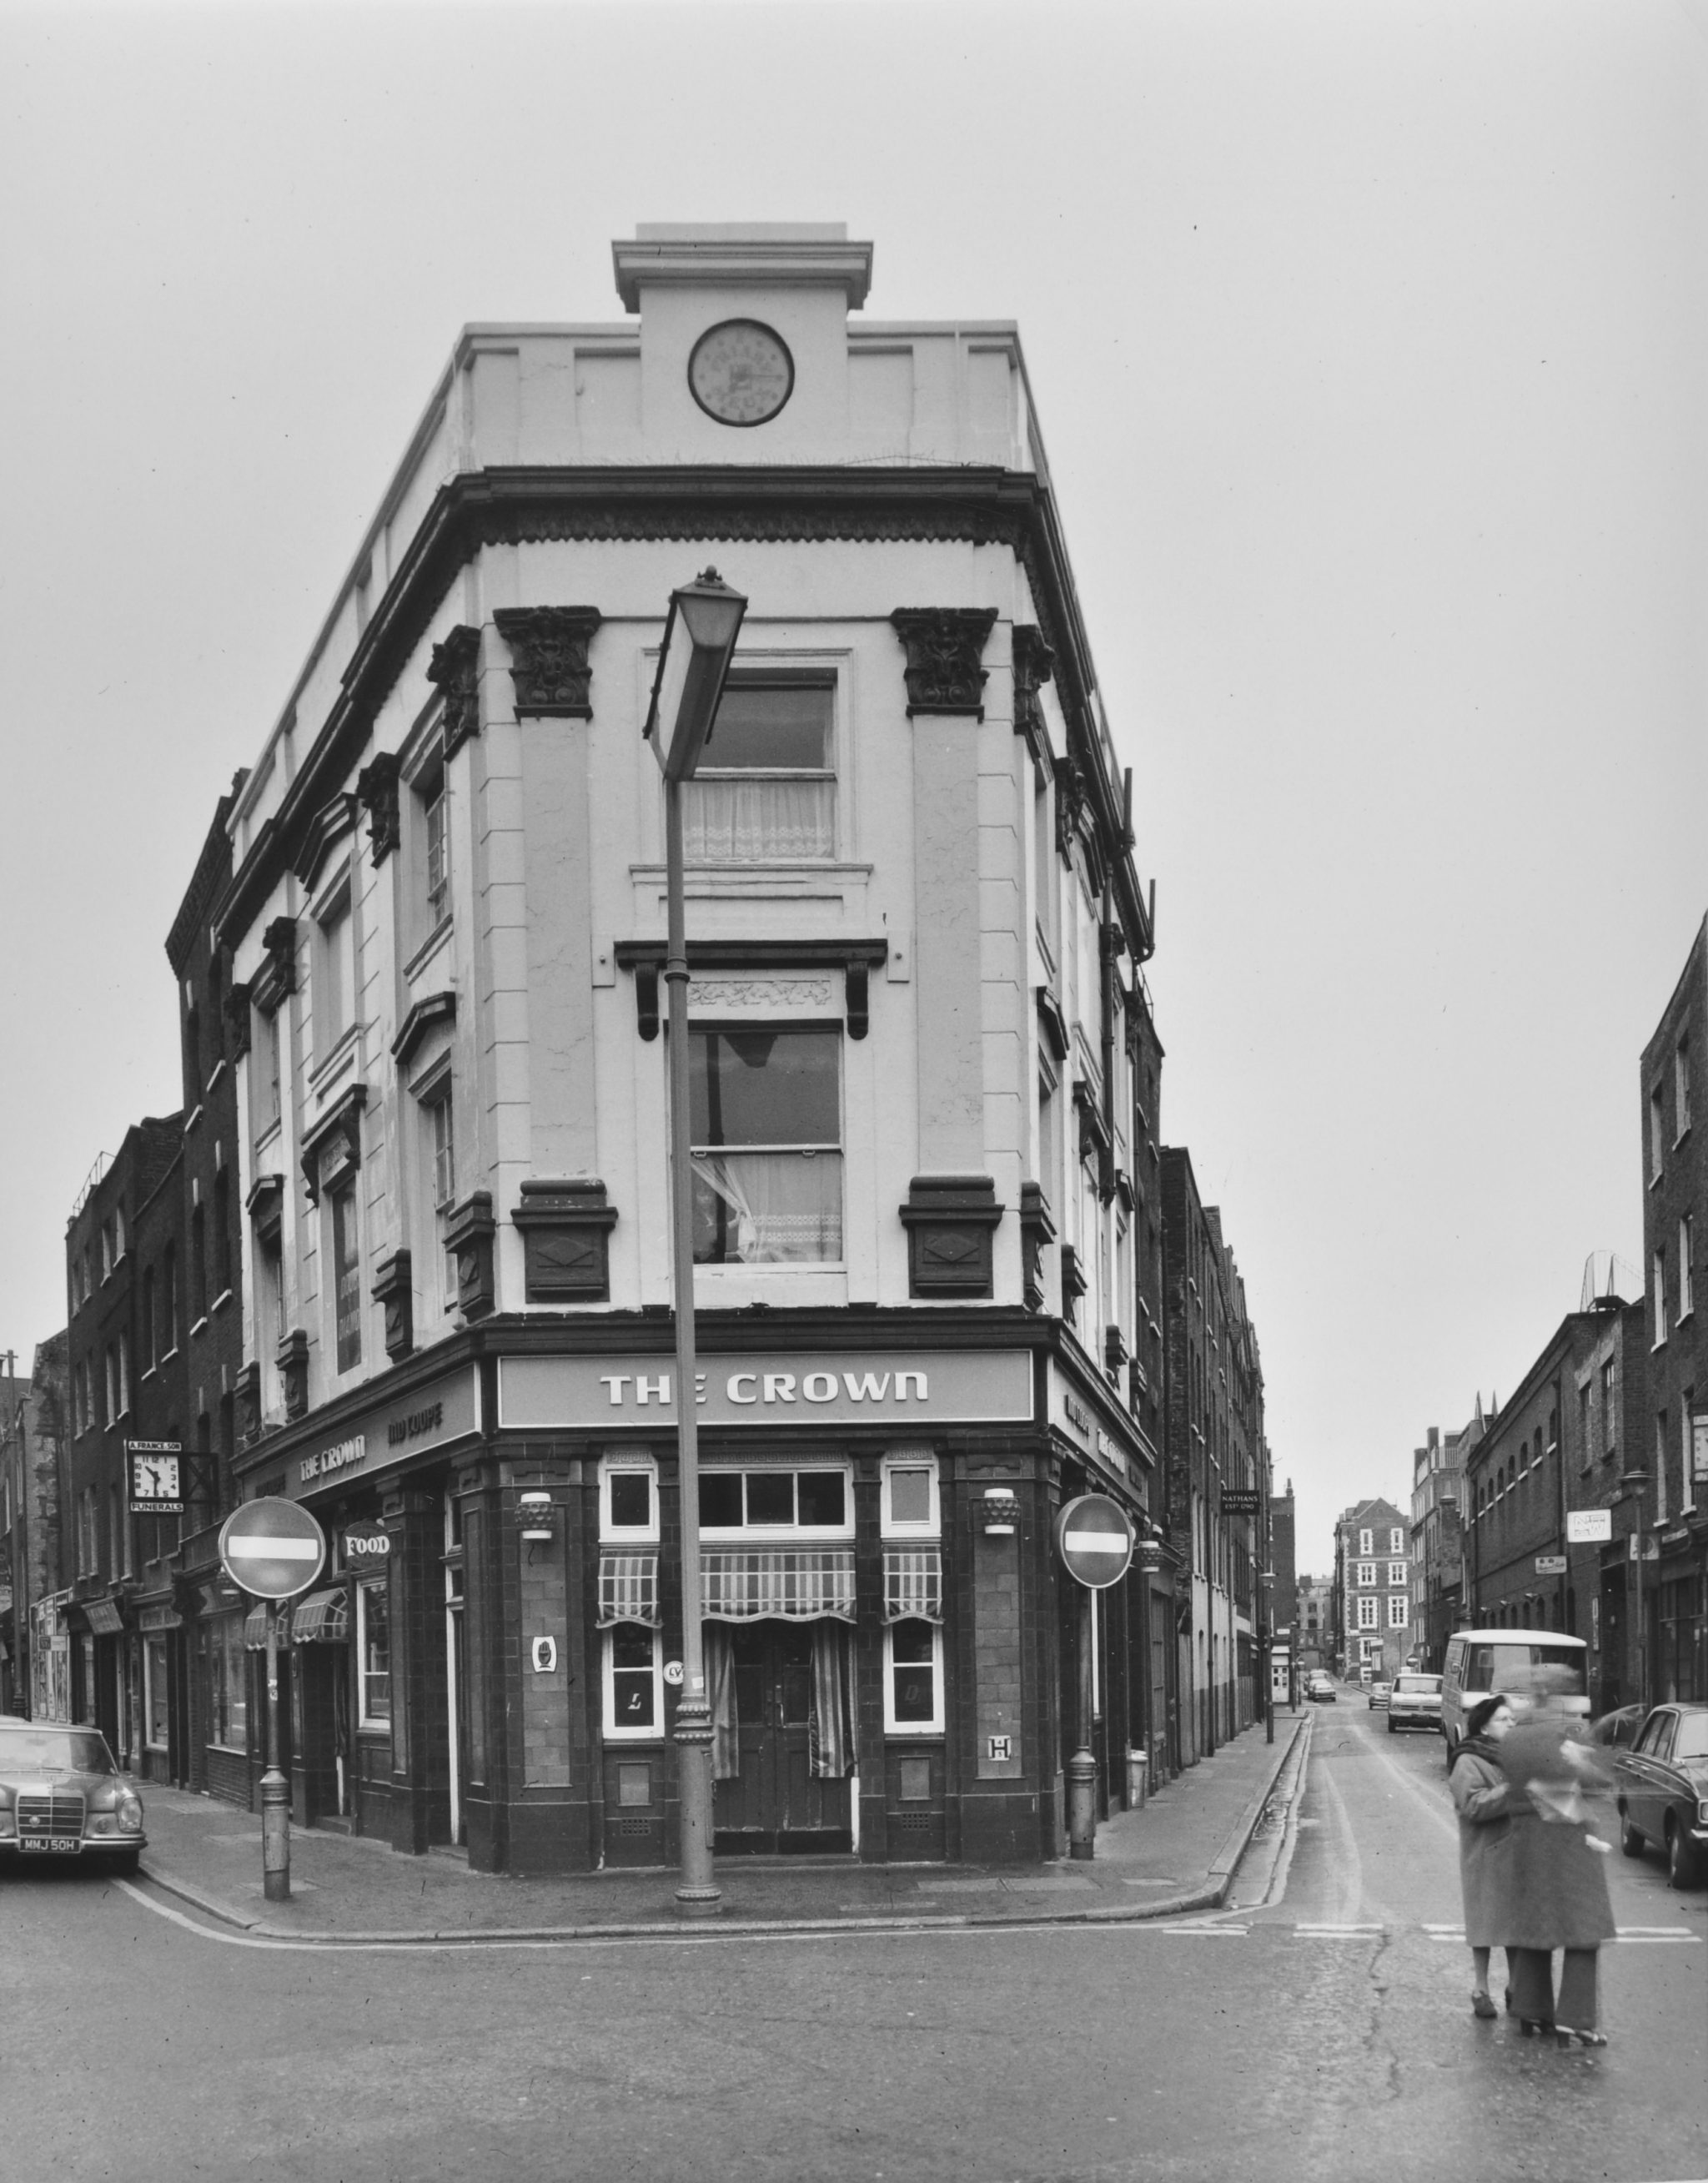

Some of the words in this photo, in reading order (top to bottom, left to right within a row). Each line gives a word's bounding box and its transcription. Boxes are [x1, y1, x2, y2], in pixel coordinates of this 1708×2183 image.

[726, 1371, 928, 1404] CROWN
[300, 1455, 320, 1481] THE
[321, 1435, 365, 1474] CROWN
[132, 1502, 183, 1511] FUNERALS
[345, 1535, 390, 1557] FOOD
[992, 1738, 1007, 1758] H
[25, 1839, 48, 1850] MMJ
[51, 1840, 74, 1850] 50H
